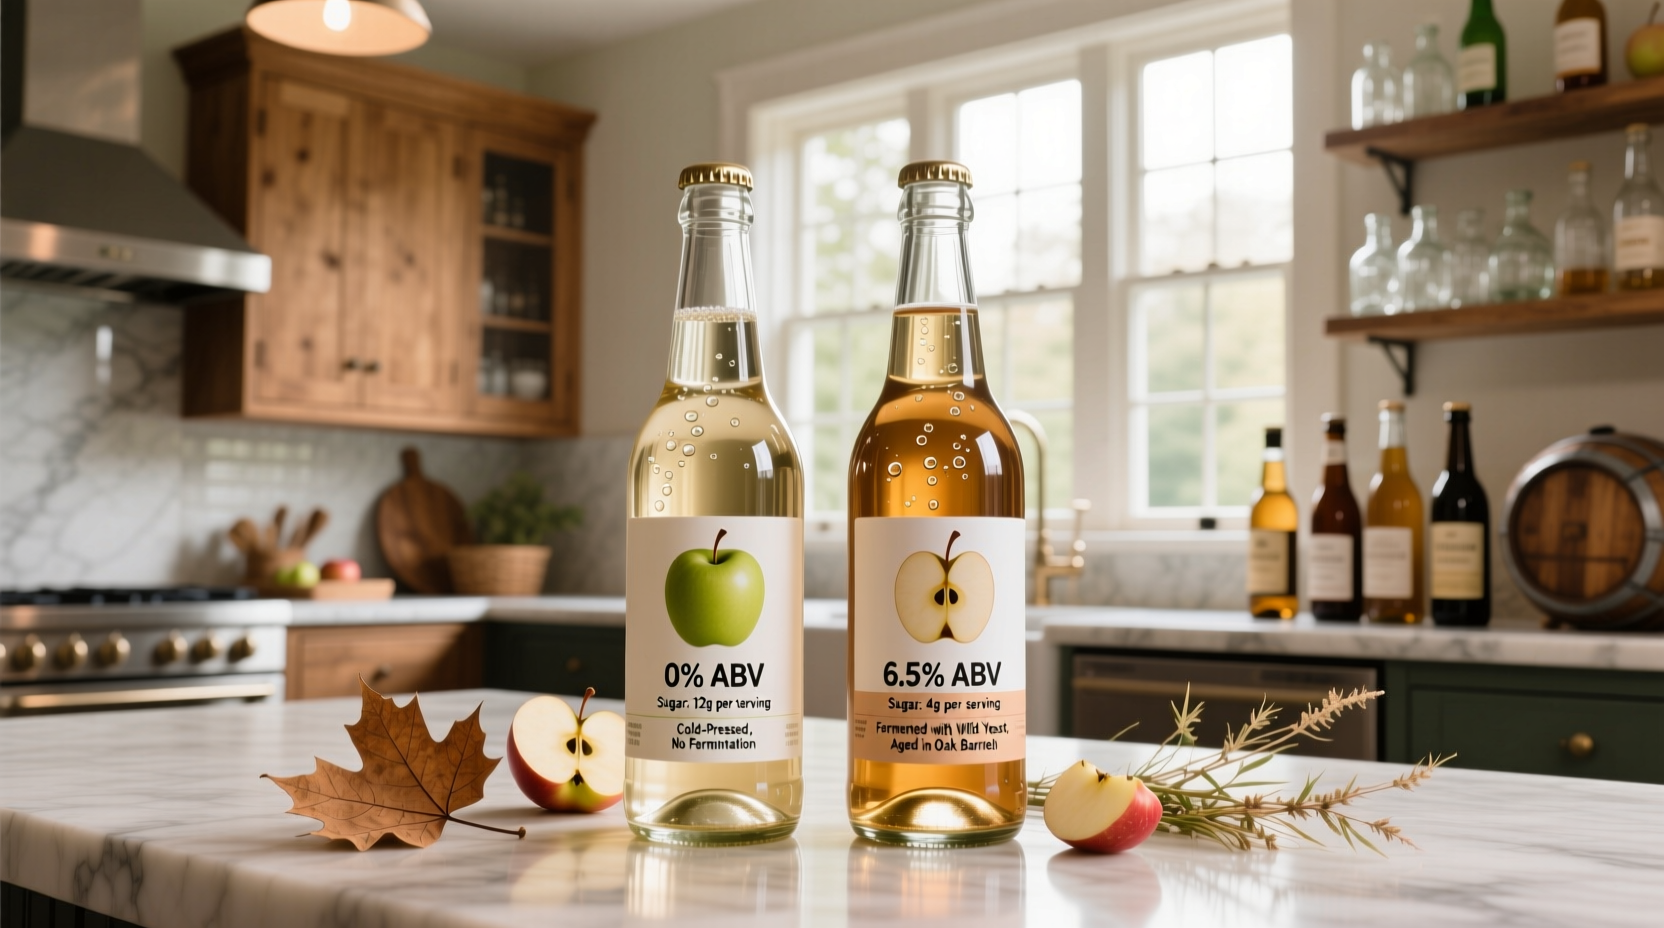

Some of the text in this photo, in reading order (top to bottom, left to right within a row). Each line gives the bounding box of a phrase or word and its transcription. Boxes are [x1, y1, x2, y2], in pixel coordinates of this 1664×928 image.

[664, 662, 765, 688] 0% ABV
[883, 661, 1002, 687] 6.5% ABV
[693, 696, 713, 712] 12g
[716, 699, 733, 712] per
[926, 697, 940, 713] 4g
[944, 700, 962, 714] per
[966, 697, 1001, 711] serving
[671, 737, 686, 750] No
[890, 737, 919, 753] Aged
[934, 738, 957, 752] Oak
